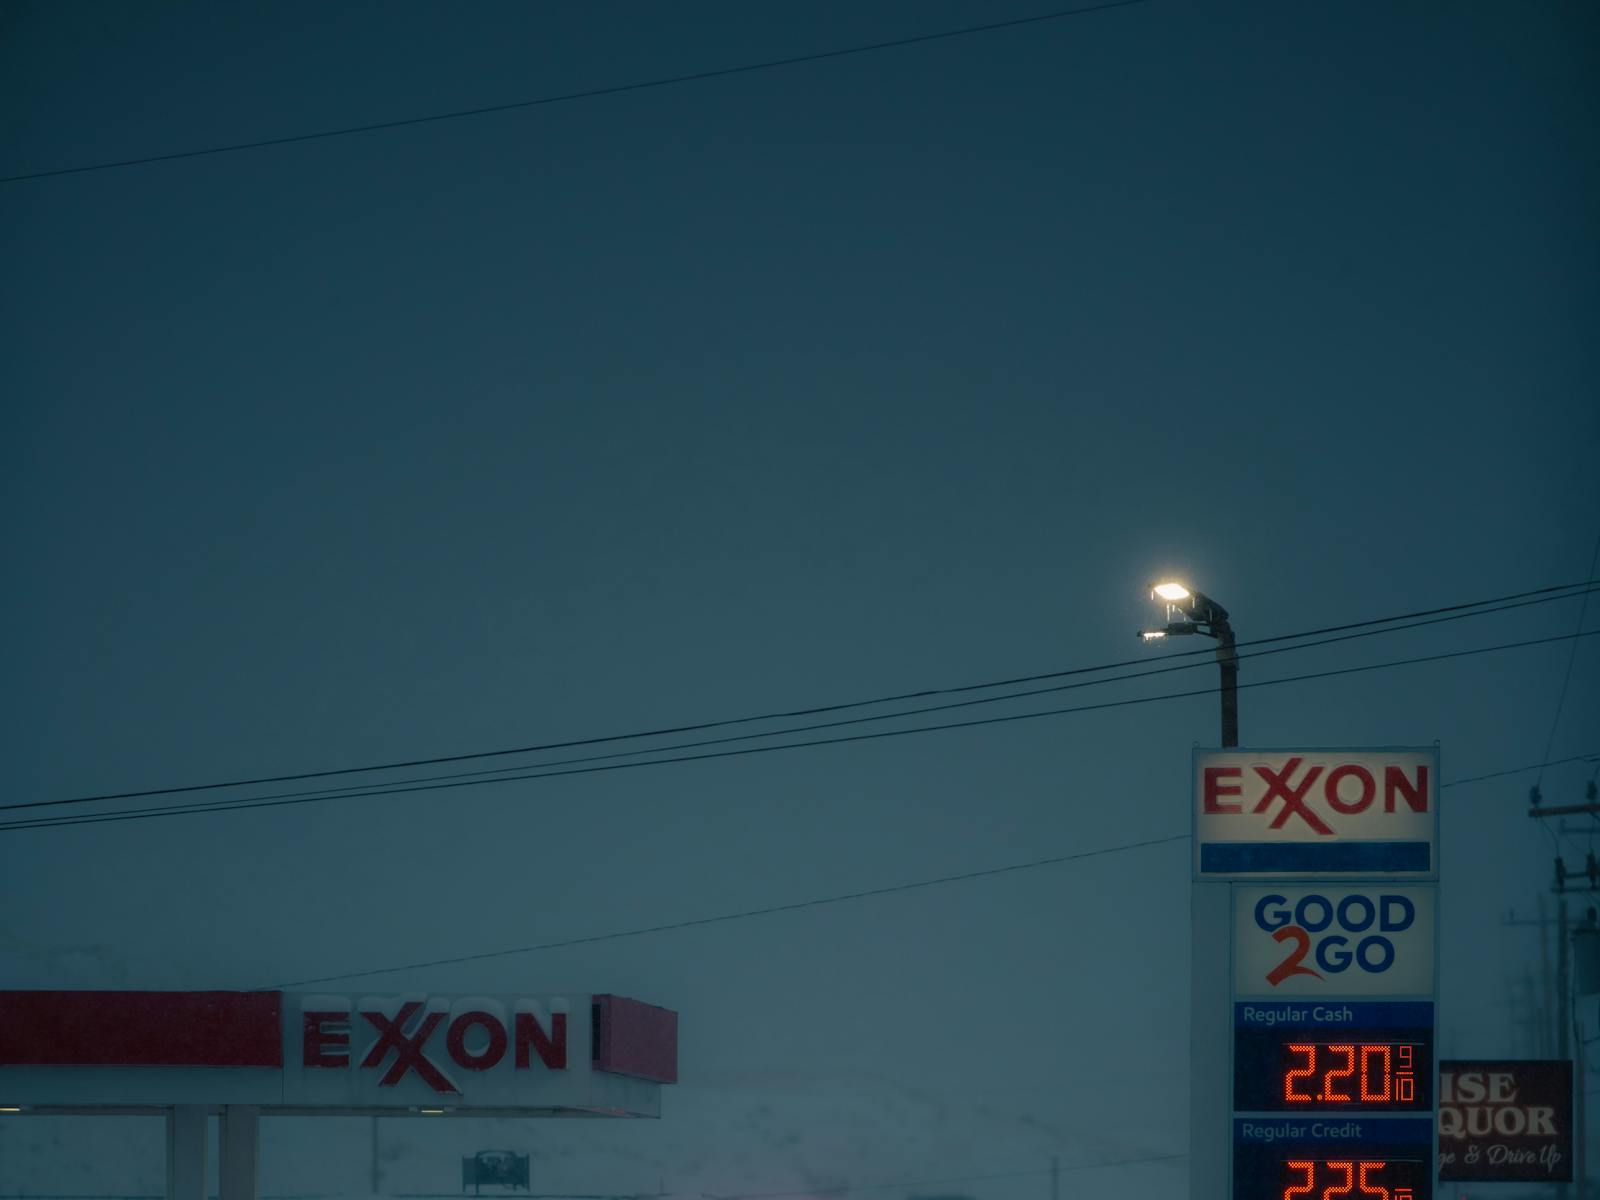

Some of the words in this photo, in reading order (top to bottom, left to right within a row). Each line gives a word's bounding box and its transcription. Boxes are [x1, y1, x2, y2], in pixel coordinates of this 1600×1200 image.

[1203, 757, 1429, 836] EXXON
[1254, 894, 1415, 933] GOOD
[1243, 1007, 1308, 1026] Regular
[1313, 1006, 1353, 1022] Cash
[303, 1001, 568, 1096] EXXON
[1286, 1045, 1391, 1102] 2.20
[1242, 1123, 1307, 1142] Regular
[1311, 1122, 1363, 1138] Credit
[1439, 1106, 1557, 1138] QUOR
[1464, 1144, 1481, 1164] &
[1487, 1144, 1537, 1165] Drive
[1539, 1143, 1561, 1172] Up
